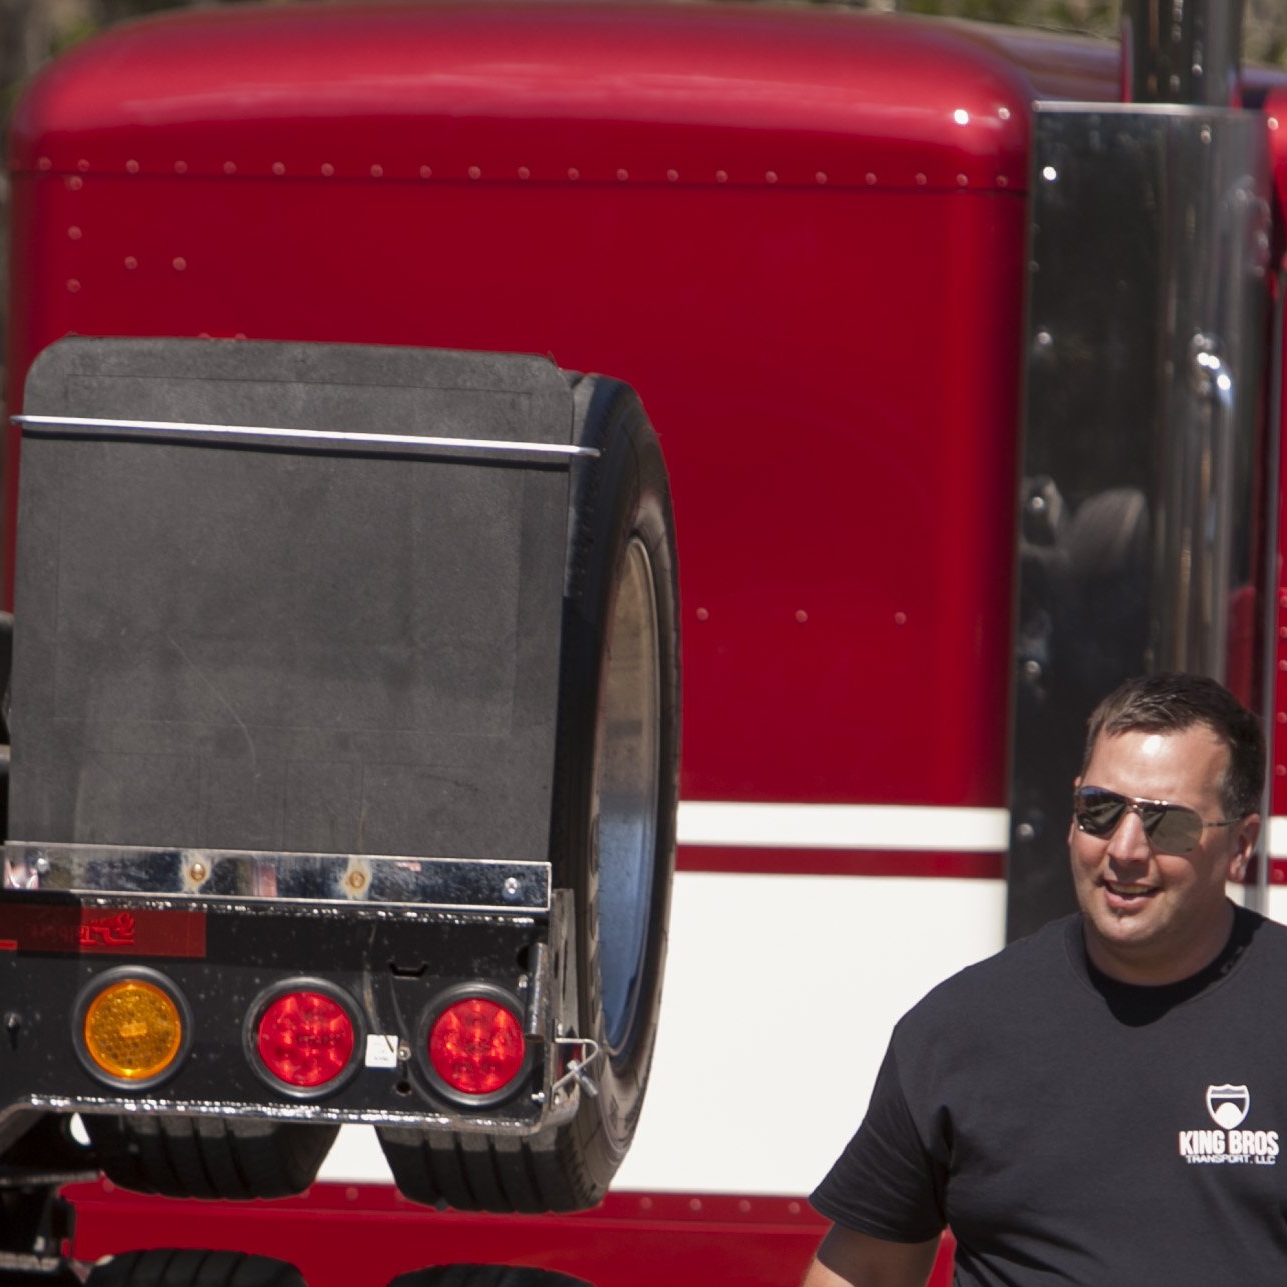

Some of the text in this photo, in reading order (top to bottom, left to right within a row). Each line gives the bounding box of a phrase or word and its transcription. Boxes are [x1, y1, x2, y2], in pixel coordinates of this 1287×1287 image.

[1179, 1130, 1280, 1156] KING BROS
[1255, 1154, 1276, 1165] LLC
